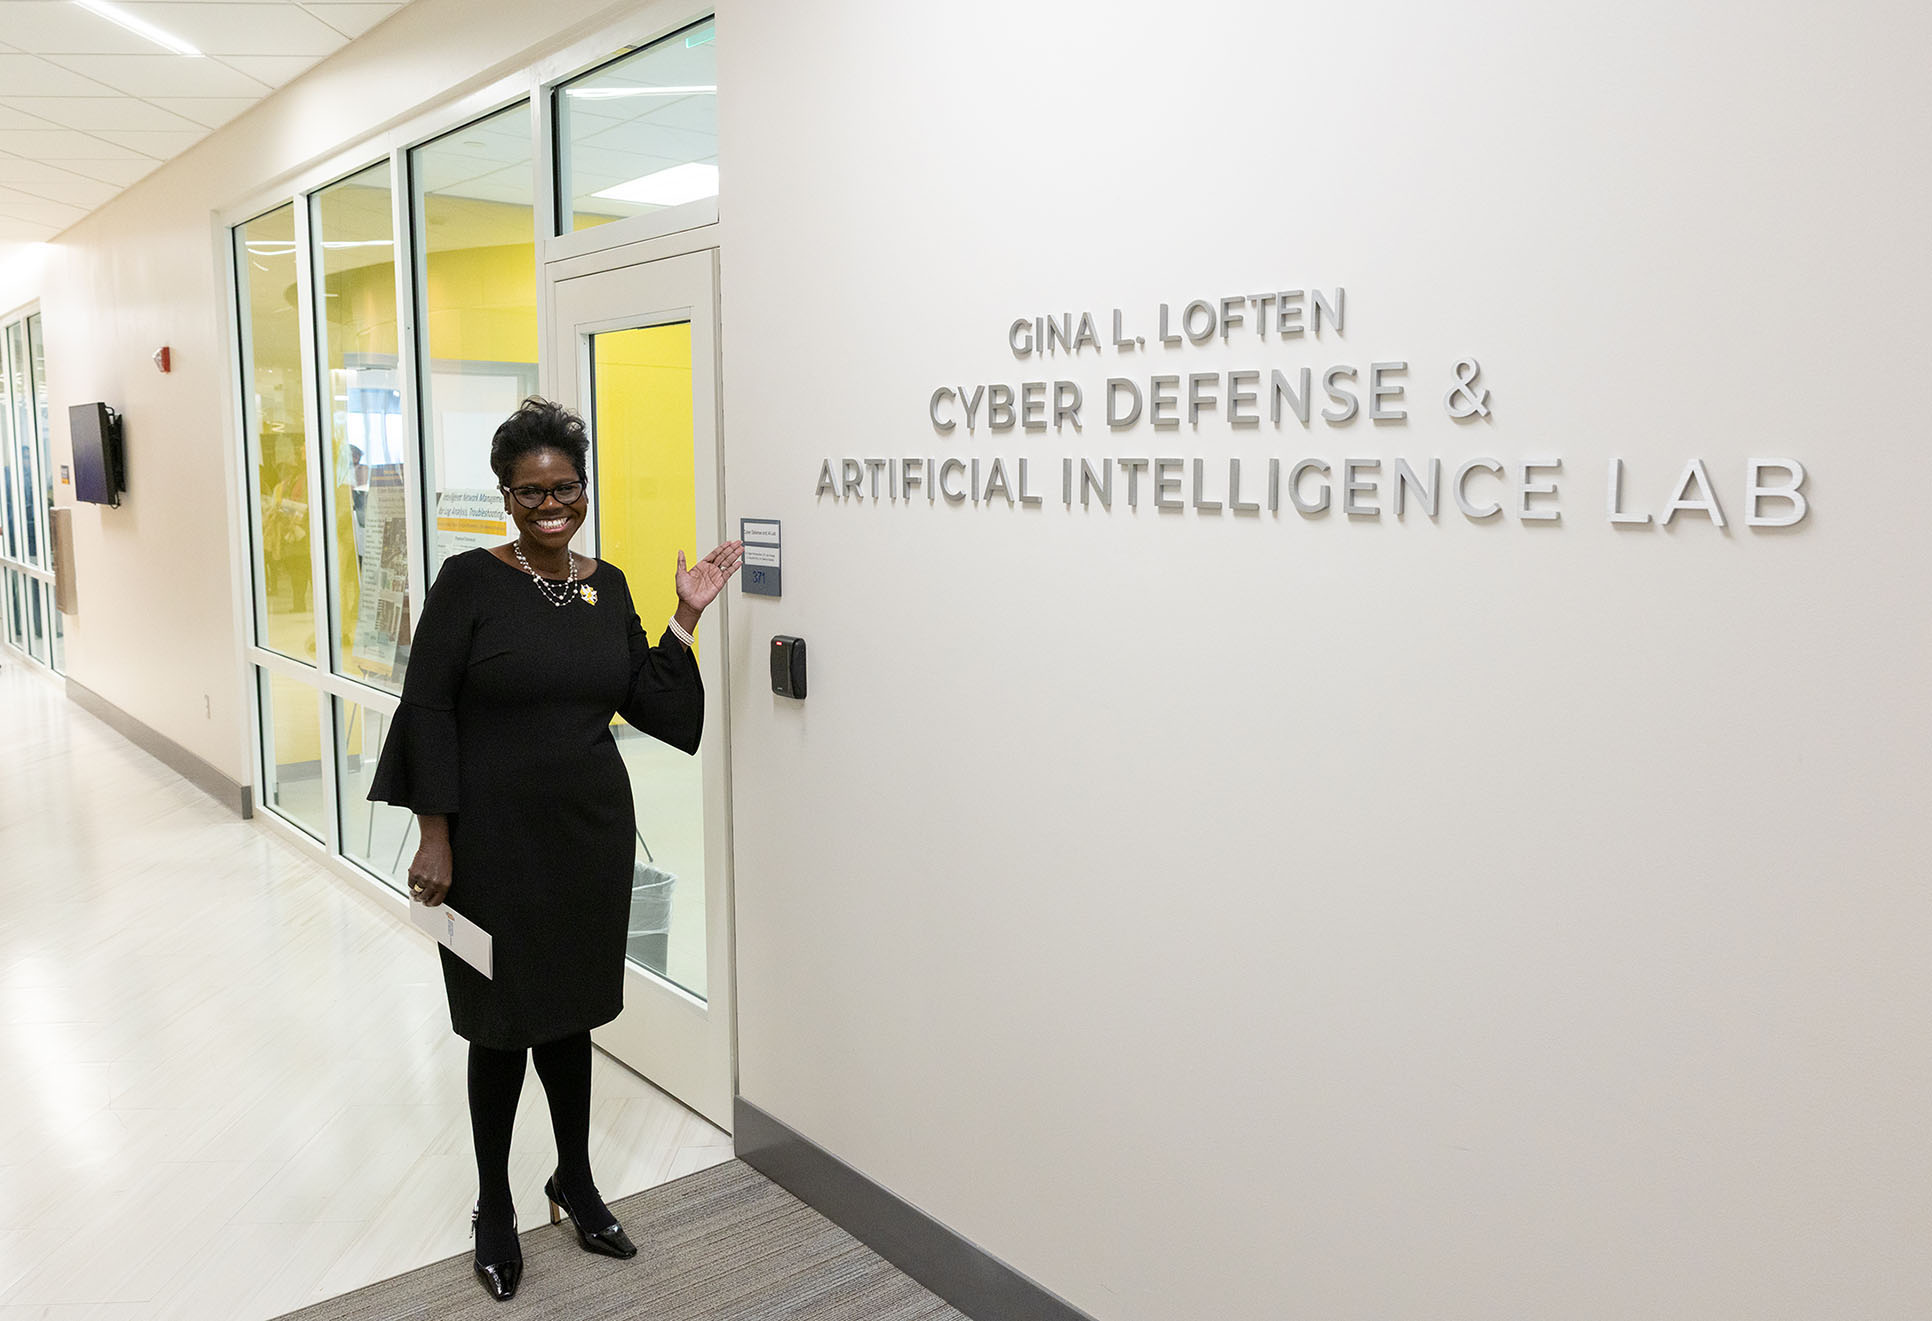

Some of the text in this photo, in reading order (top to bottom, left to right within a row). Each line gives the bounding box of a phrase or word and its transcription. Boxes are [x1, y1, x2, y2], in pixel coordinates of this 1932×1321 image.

[1009, 287, 1345, 354] GINA L. LOFTEN
[929, 357, 1490, 430] CYBER DEFENSE &
[815, 457, 1809, 527] ARTIFICIAL INTELLIGENCE LAB
[752, 569, 766, 584] 371
